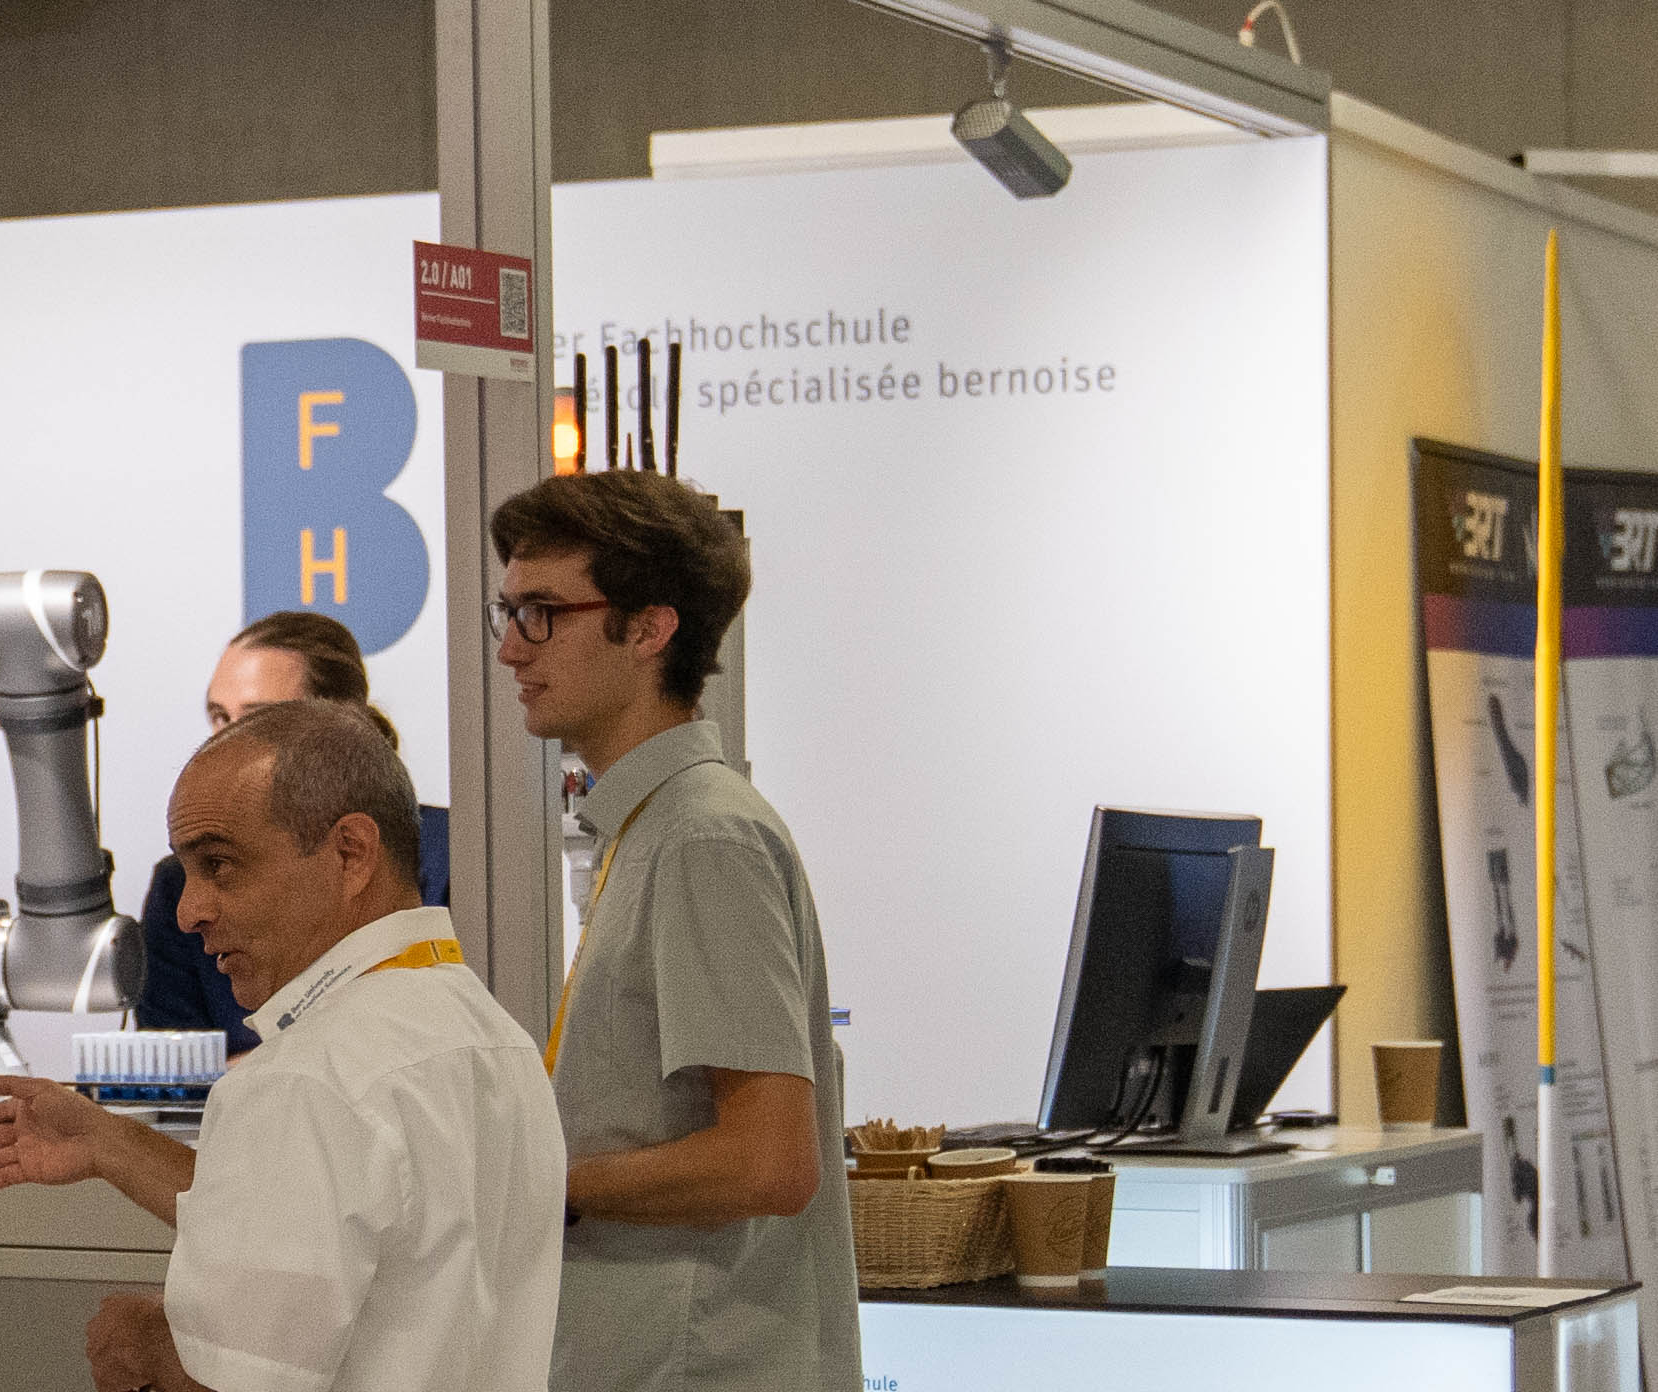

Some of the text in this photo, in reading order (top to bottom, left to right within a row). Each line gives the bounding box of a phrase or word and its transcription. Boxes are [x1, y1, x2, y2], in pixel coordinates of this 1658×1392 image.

[420, 259, 439, 286] 2.0
[449, 264, 472, 291] A01
[601, 307, 912, 357] Fachhochschule
[698, 361, 922, 415] spécialisée
[937, 358, 1117, 399] bernoise
[298, 389, 345, 471] F
[300, 526, 348, 606] H
